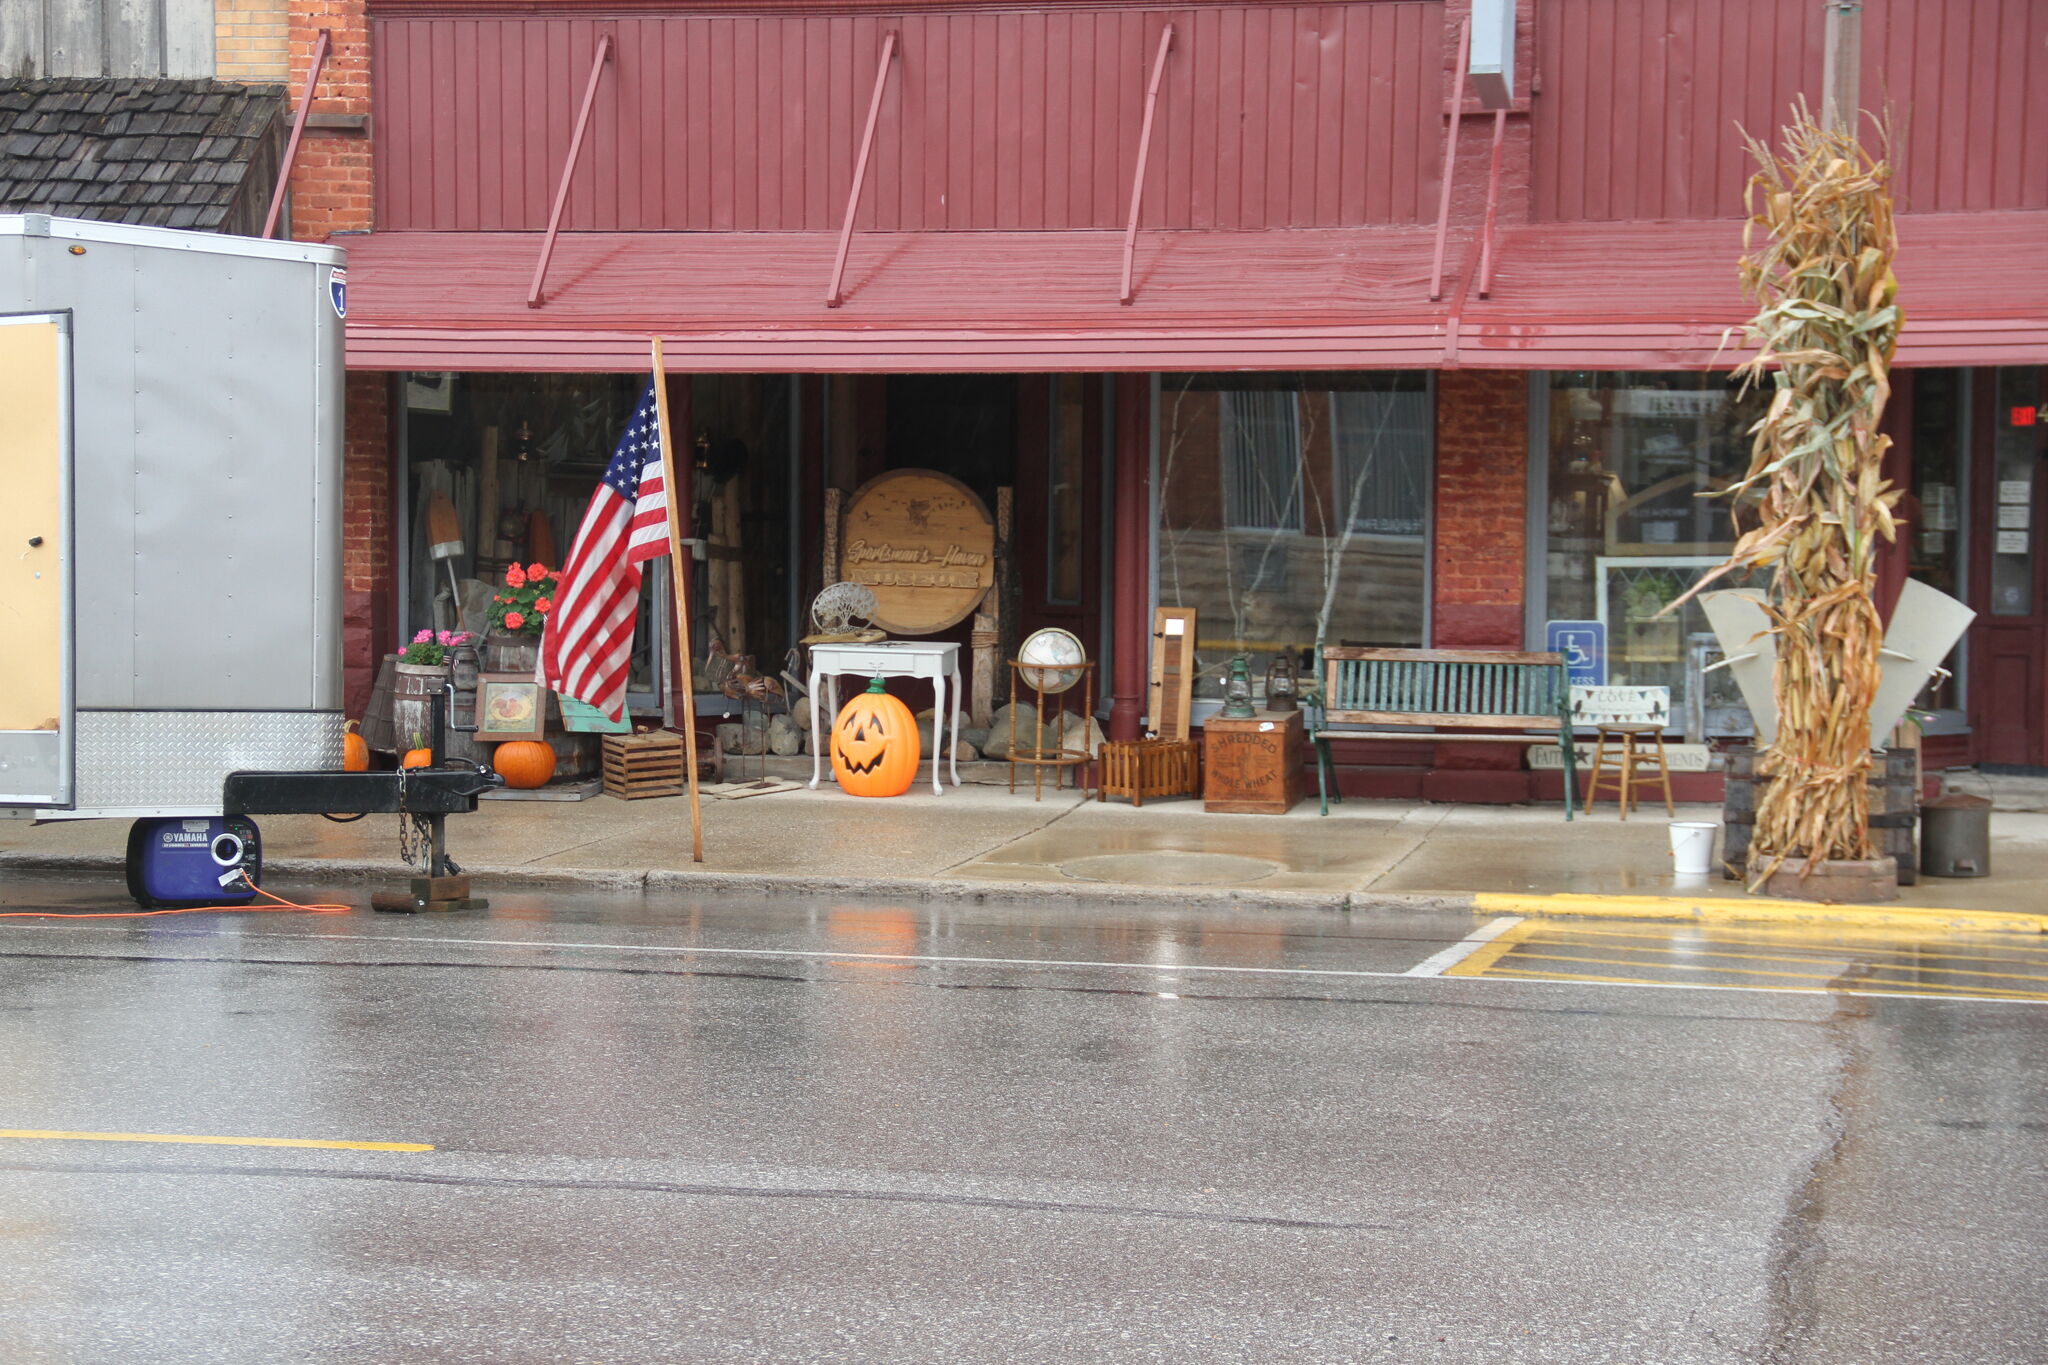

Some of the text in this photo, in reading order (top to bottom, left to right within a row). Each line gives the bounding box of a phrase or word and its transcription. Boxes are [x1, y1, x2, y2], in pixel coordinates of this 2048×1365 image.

[338, 287, 345, 312] 1
[848, 539, 987, 568] Sportsman's Haven
[851, 569, 980, 589] MUSEUM
[1598, 689, 1637, 703] LOVE
[1211, 732, 1277, 754] SHREDDED
[1211, 769, 1278, 789] WHOLE WHEAT
[173, 832, 208, 842] YAMAHA
